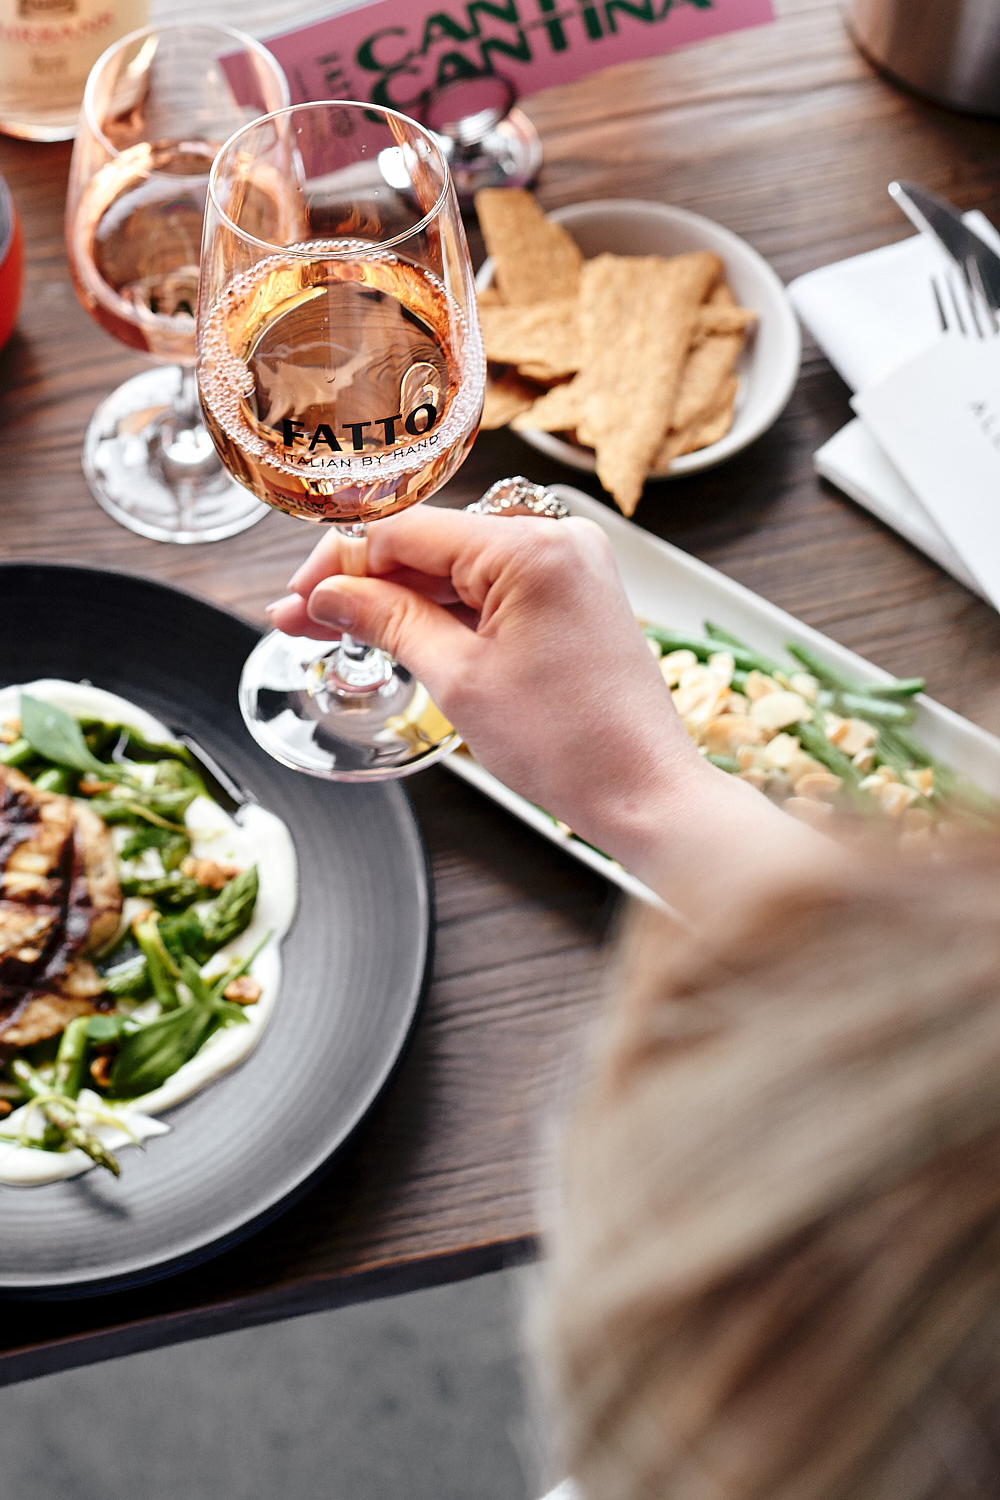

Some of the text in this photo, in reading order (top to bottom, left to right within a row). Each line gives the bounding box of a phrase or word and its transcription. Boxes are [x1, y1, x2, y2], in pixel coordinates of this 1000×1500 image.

[282, 403, 438, 452] FATTO
[283, 434, 440, 468] ITALIAN BY HAND
